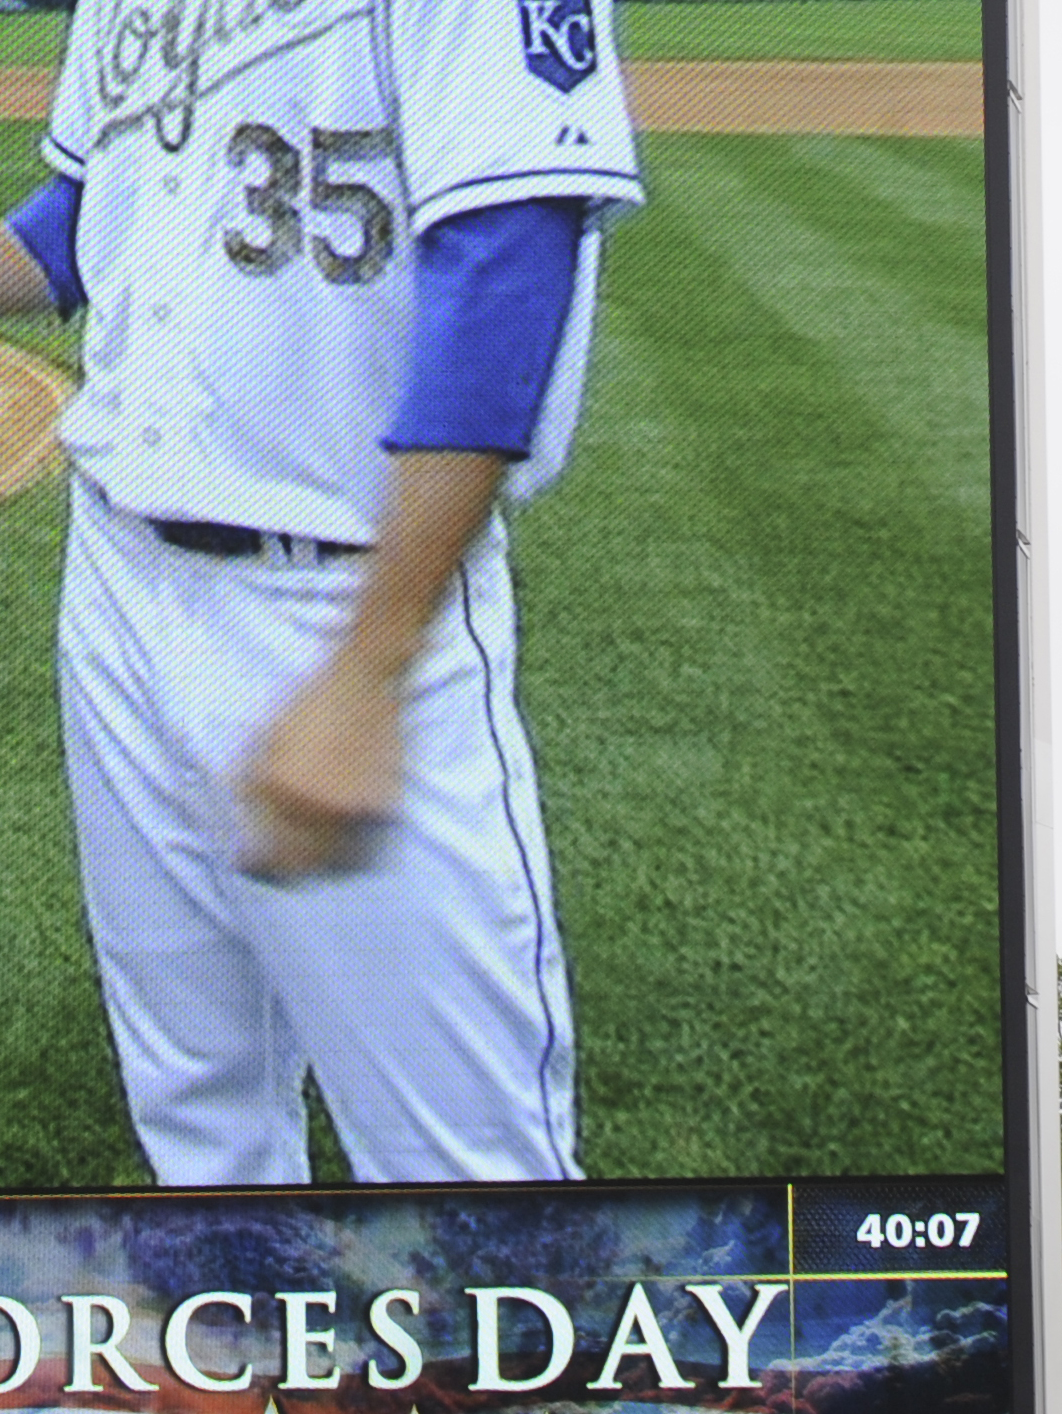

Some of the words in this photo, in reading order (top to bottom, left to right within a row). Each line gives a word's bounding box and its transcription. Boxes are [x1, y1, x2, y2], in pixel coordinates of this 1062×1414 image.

[524, 0, 596, 72] KC
[223, 123, 396, 286] 35
[856, 1212, 981, 1248] 40:07
[464, 1282, 789, 1392] DAY
